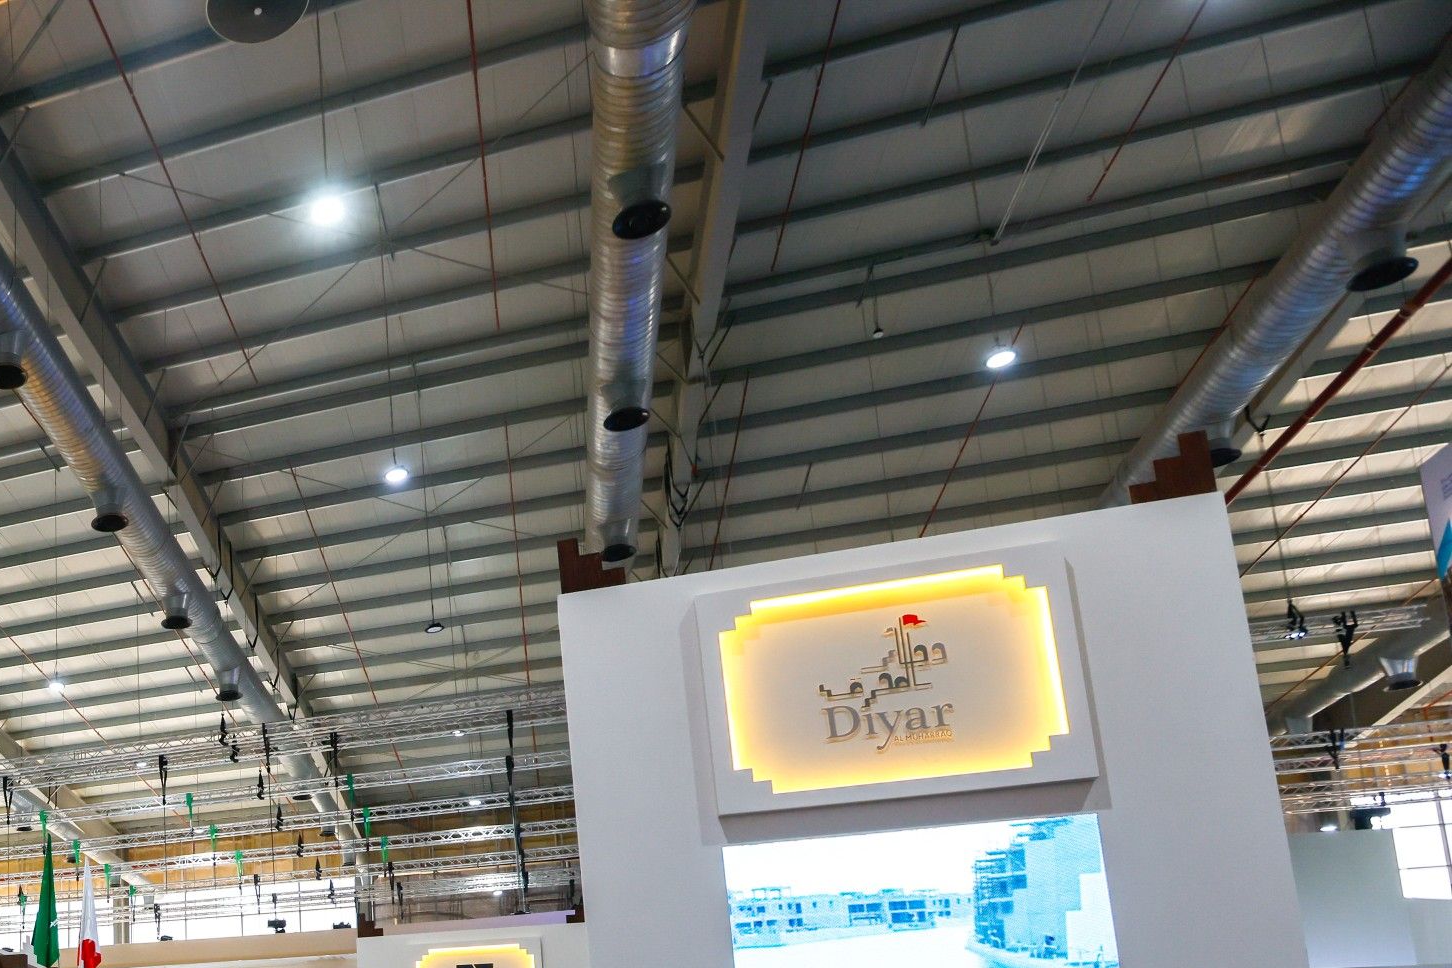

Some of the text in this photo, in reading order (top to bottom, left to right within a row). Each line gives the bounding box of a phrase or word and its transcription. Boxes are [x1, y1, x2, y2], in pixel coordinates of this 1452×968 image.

[821, 702, 954, 752] Diyar
[894, 730, 953, 742] AL MUHARRAQ
